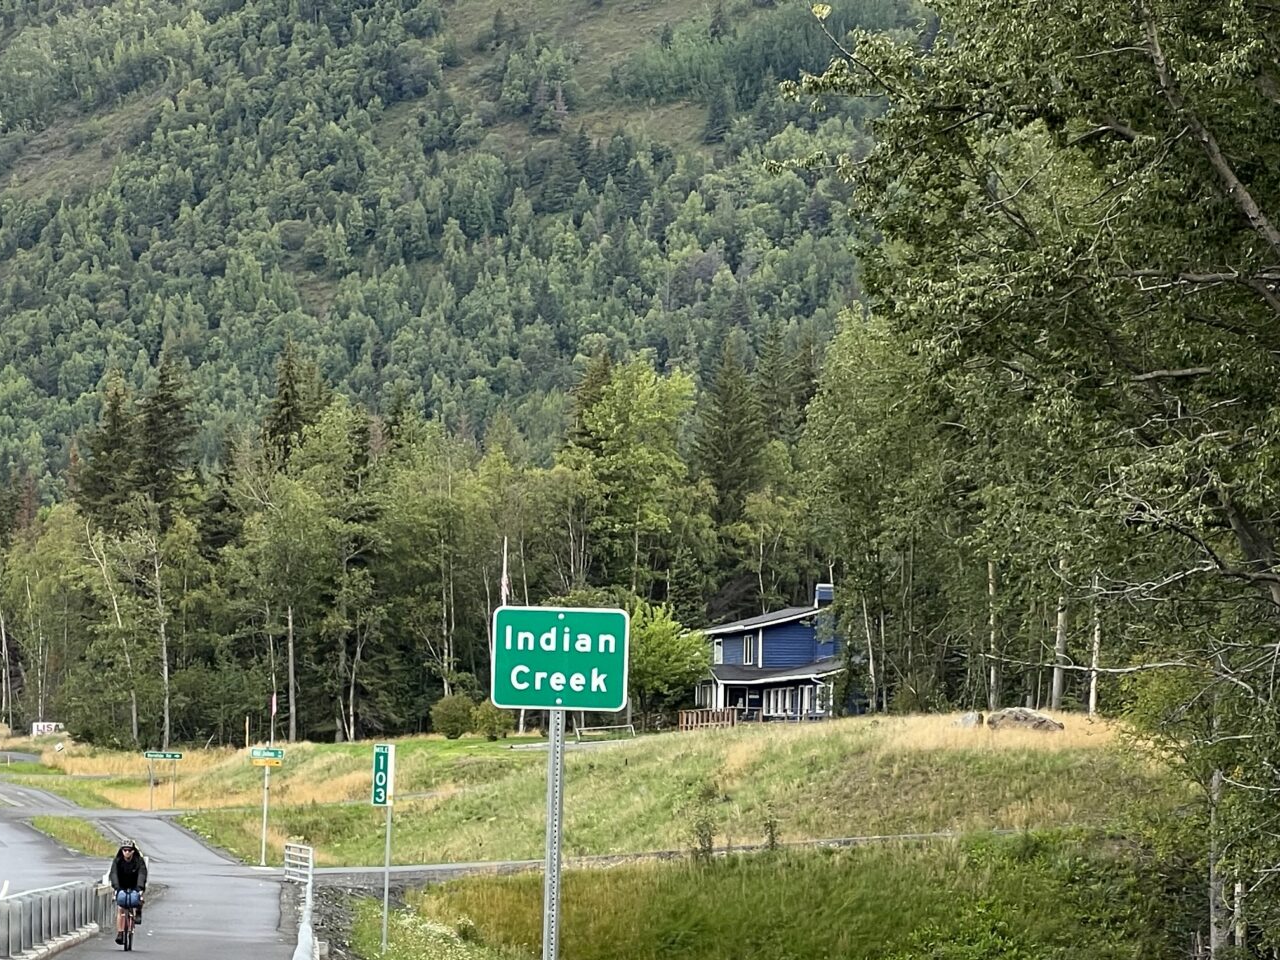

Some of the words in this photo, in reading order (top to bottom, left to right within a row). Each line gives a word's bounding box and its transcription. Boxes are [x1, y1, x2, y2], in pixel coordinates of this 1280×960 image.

[505, 625, 616, 653] Indian
[510, 664, 608, 693] Creek
[375, 755, 387, 803] 103
